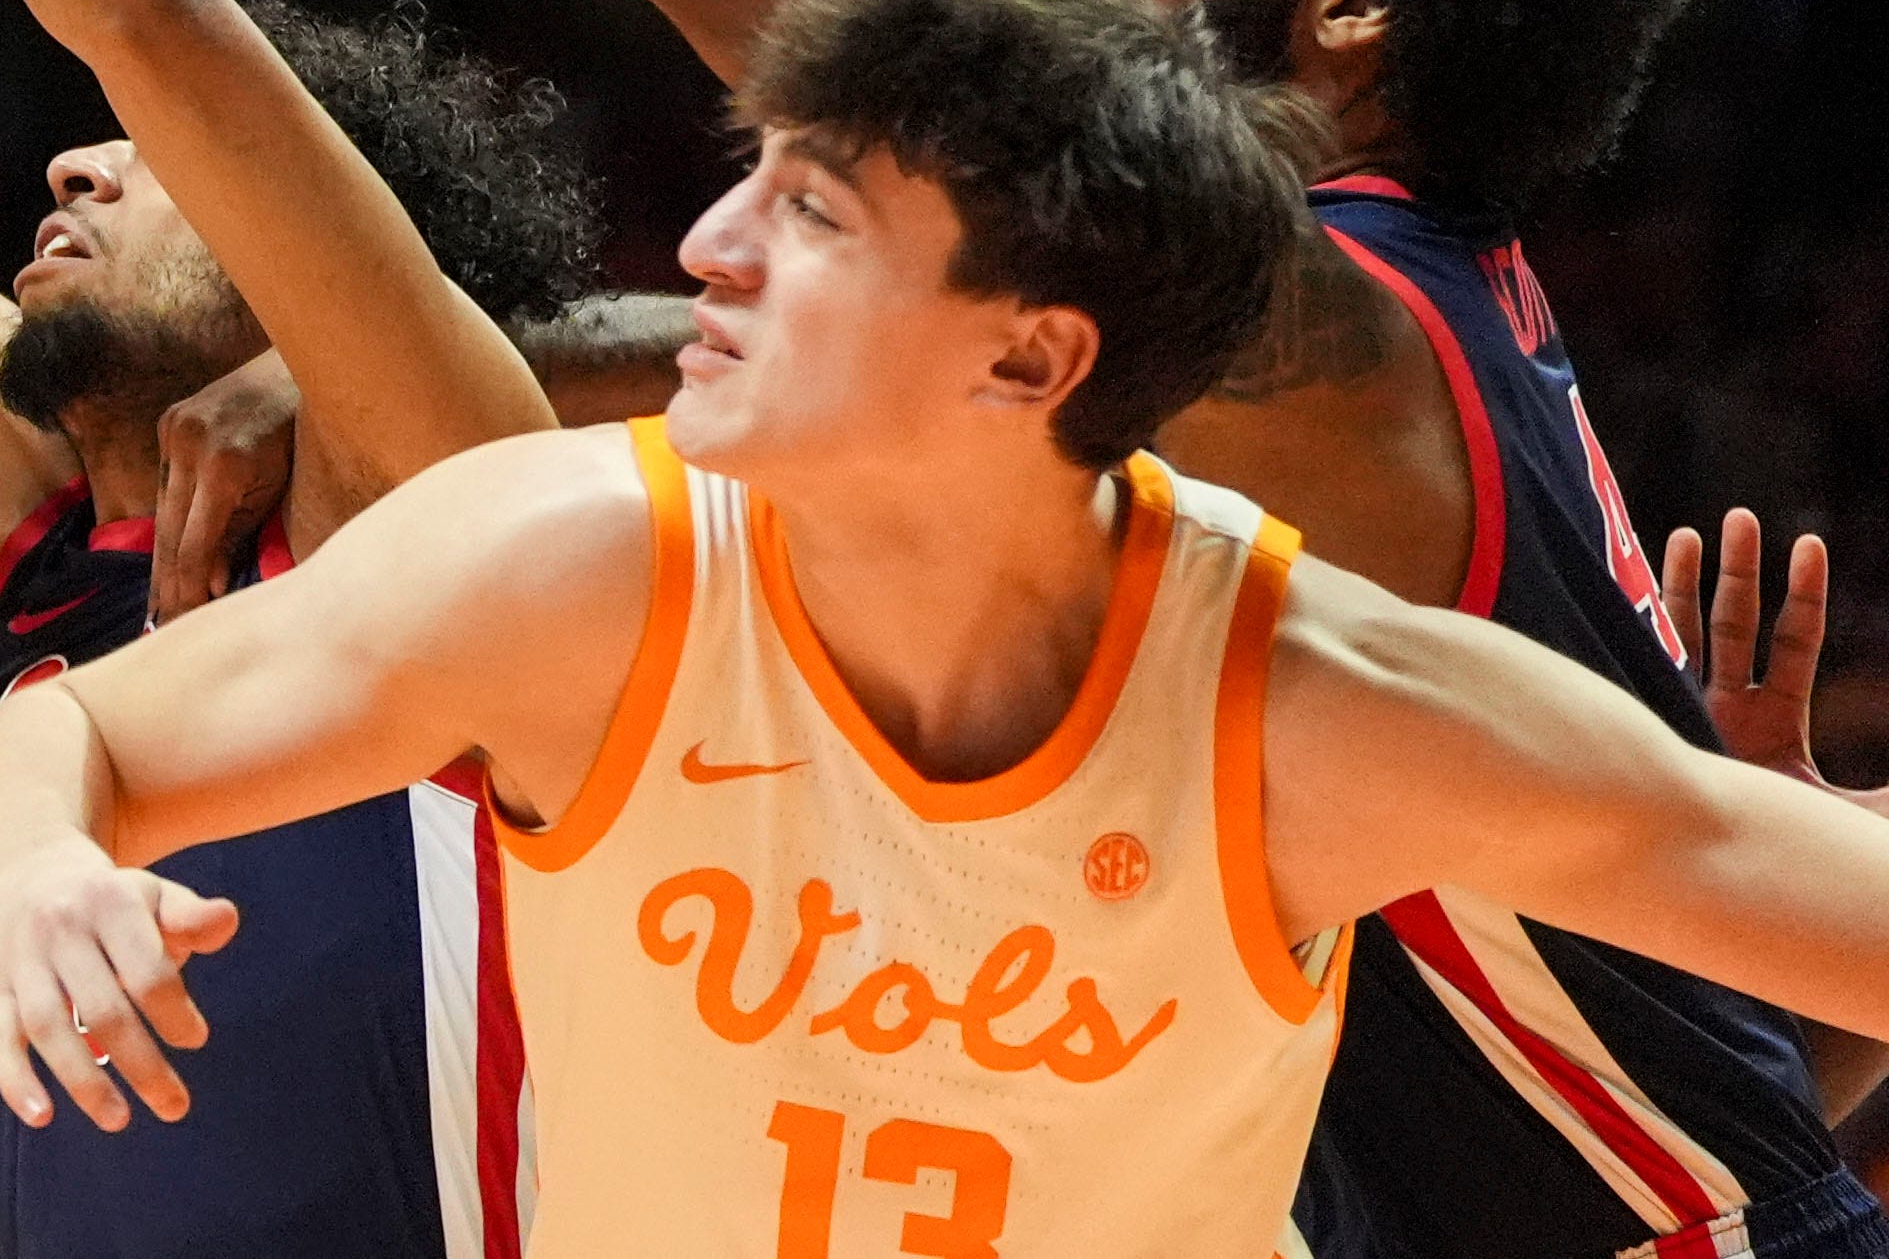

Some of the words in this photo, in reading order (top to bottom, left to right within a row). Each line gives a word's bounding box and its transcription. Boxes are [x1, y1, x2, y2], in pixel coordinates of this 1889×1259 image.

[1091, 838, 1142, 892] SEC
[637, 866, 1178, 1083] Vols
[766, 1099, 1012, 1259] 13
